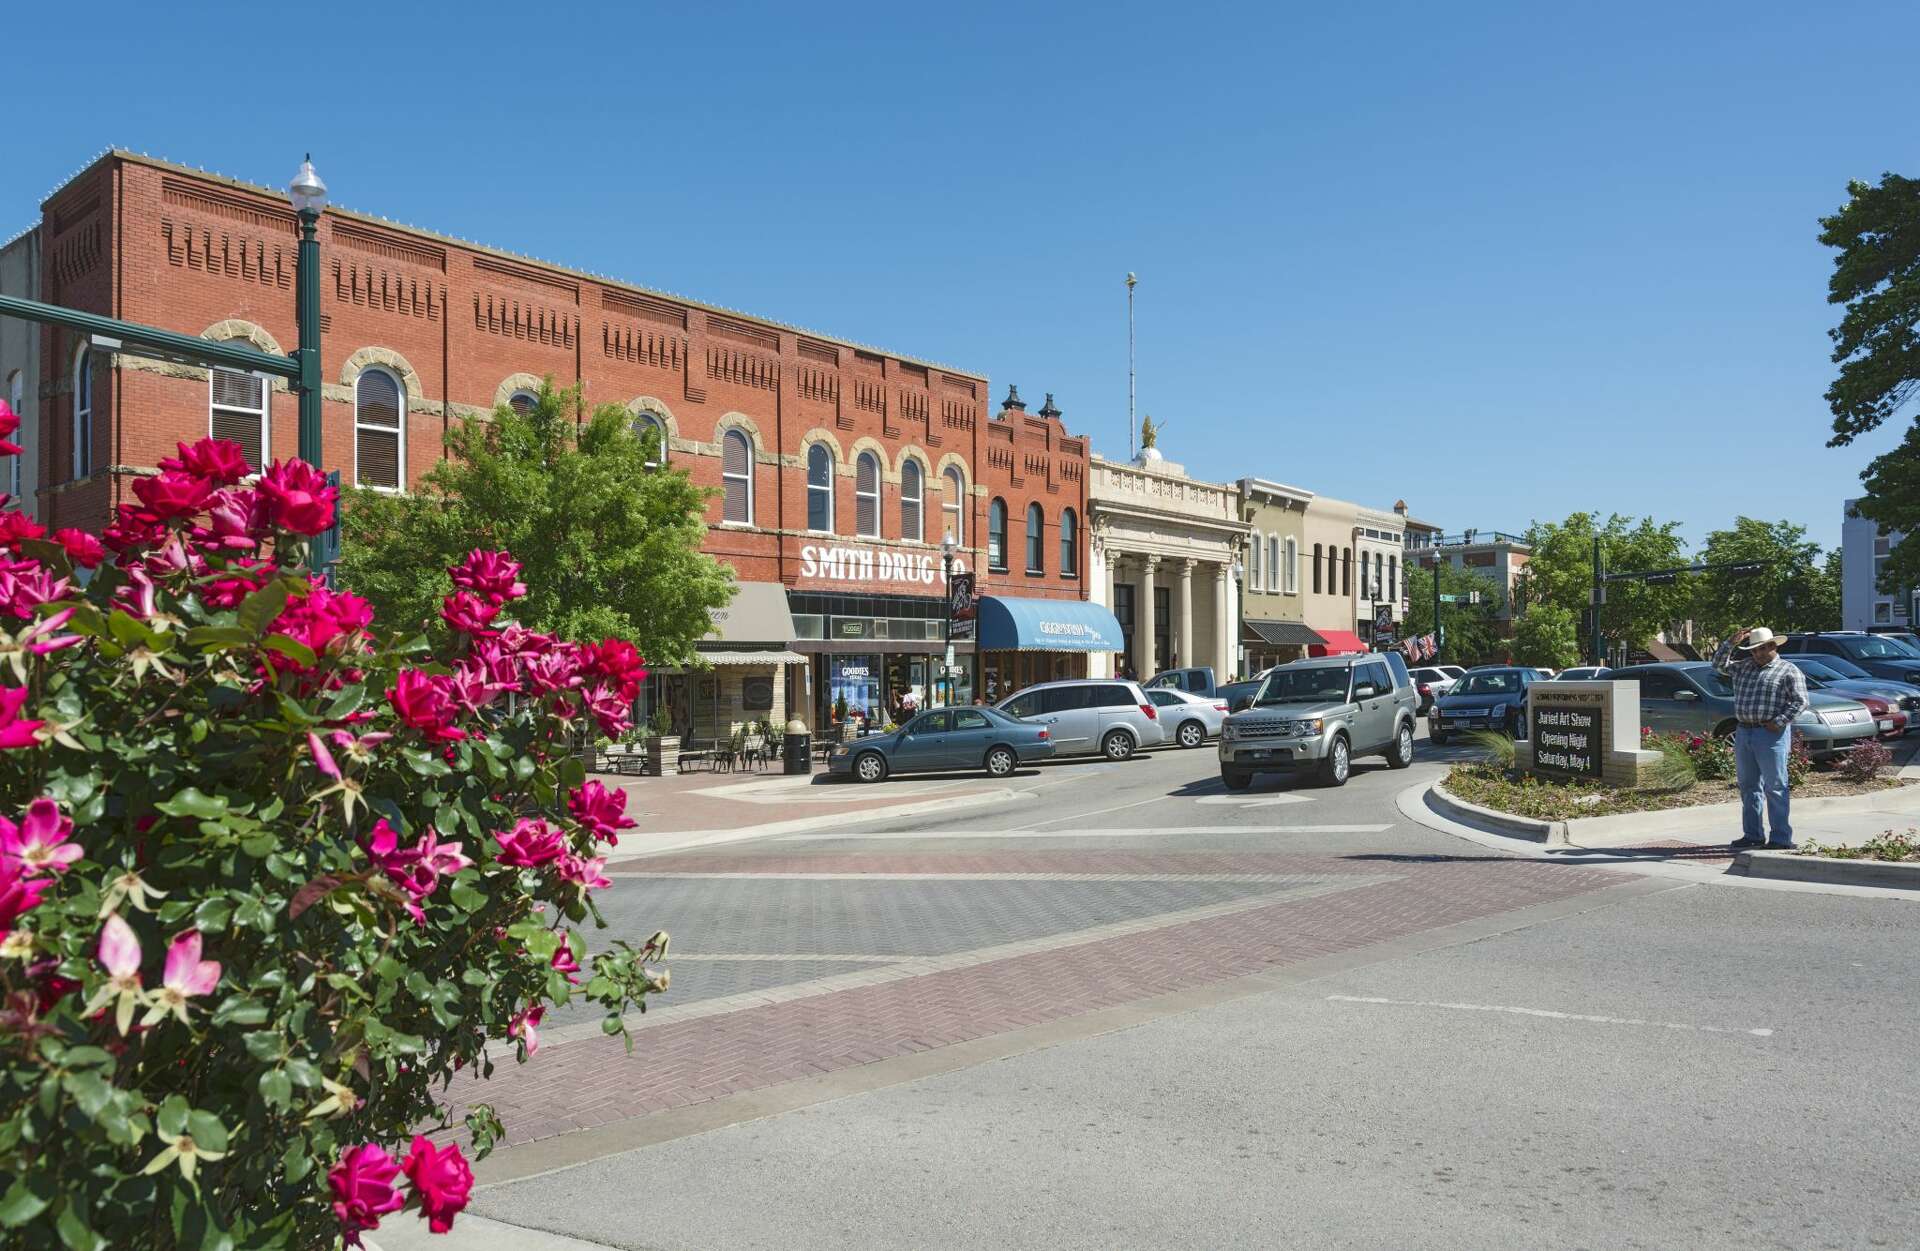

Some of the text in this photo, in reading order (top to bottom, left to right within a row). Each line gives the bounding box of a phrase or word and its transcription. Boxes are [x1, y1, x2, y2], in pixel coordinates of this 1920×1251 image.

[801, 545, 873, 580] SMITH
[879, 552, 934, 584] DRUG
[842, 667, 869, 676] GOODIES
[1538, 712, 1591, 727] Juried Art Show
[1541, 731, 1587, 749] Opening Night
[1538, 750, 1568, 769] Saturday,
[1569, 754, 1585, 771] May
